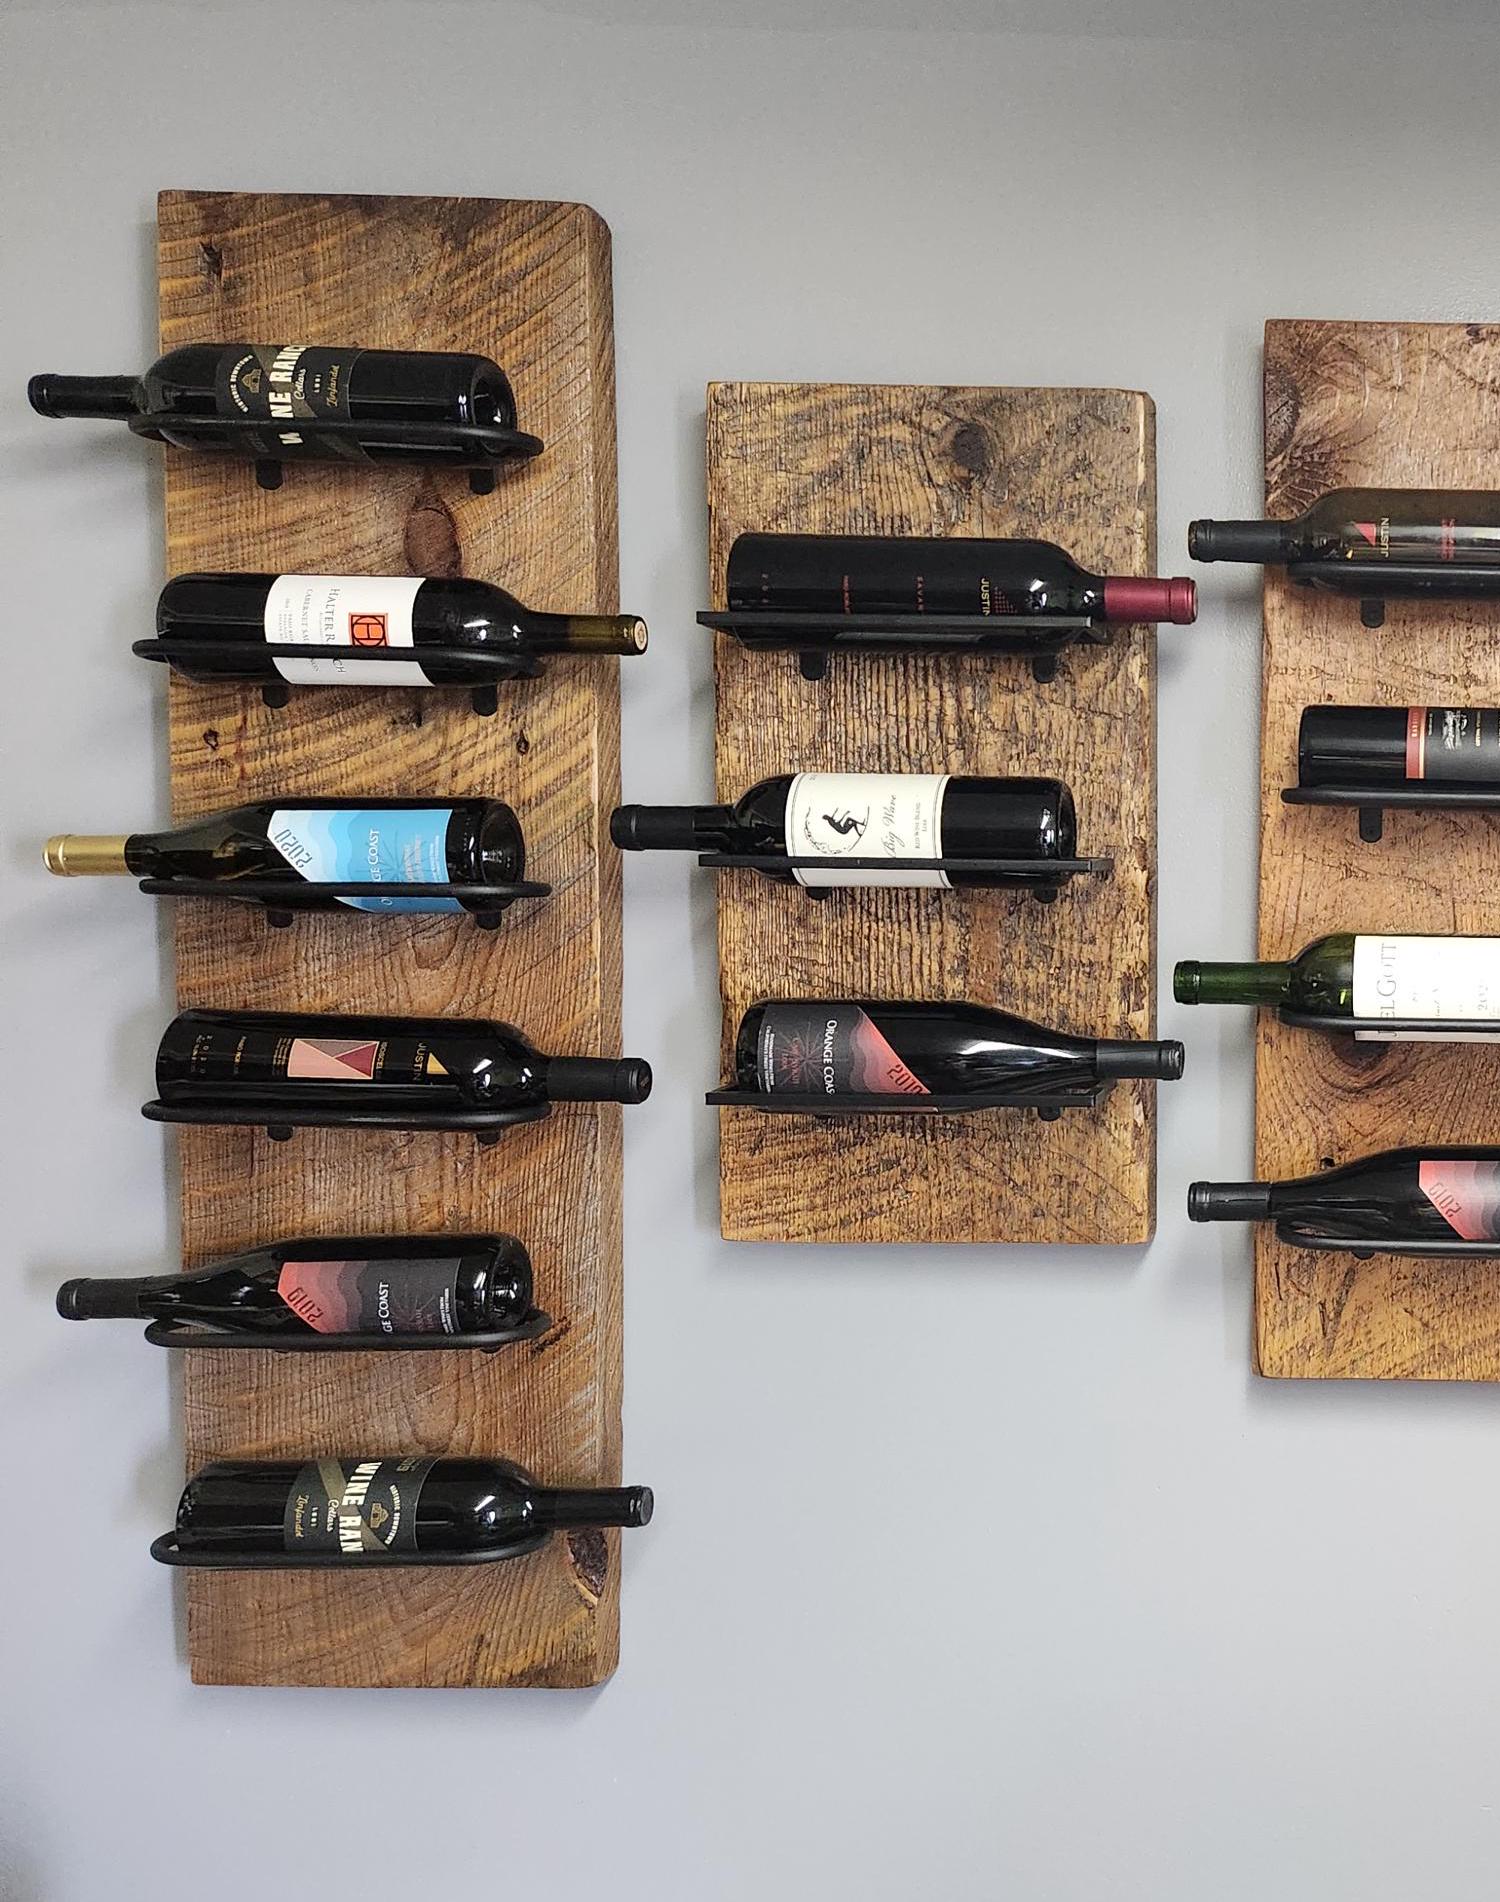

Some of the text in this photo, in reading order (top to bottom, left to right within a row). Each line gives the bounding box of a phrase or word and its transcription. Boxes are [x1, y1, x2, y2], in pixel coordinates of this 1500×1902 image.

[293, 368, 307, 400] Cellars
[326, 364, 340, 408] Zinfandel
[1380, 517, 1390, 558] JUSTIN
[301, 589, 314, 627] CABERNET
[324, 588, 340, 631] HALTER
[880, 794, 905, 858] Big Wave
[274, 828, 313, 868] 2020
[367, 829, 380, 864] COAST
[412, 1042, 427, 1081] JUSTIN
[823, 1020, 838, 1095] ORANGE COAS
[1428, 1182, 1462, 1218] 2019
[287, 1287, 324, 1322] 2019
[378, 1282, 390, 1318] COAST
[294, 1495, 310, 1538] Zinfandel
[326, 1499, 340, 1532] Cellars
[339, 1461, 383, 1552] WINE RAN
